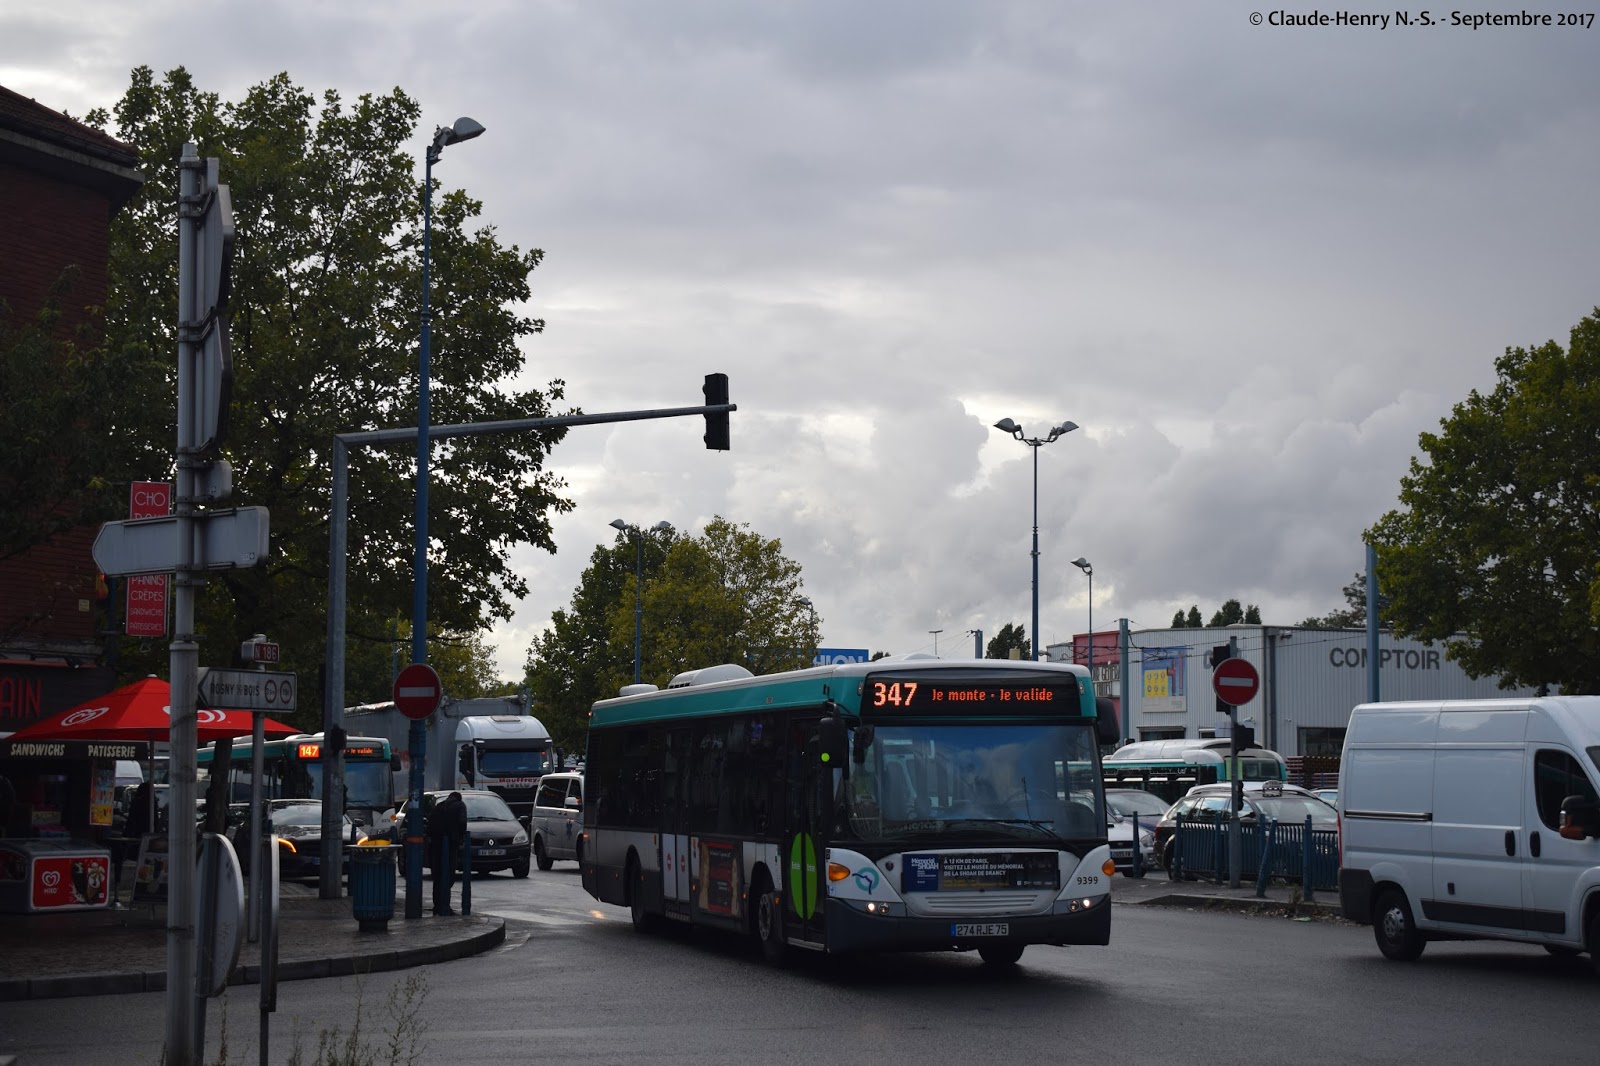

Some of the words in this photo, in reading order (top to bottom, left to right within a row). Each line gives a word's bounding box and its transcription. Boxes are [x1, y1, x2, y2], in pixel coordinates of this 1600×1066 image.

[134, 491, 166, 507] CHO
[129, 607, 163, 617] SANDWICHS
[255, 644, 260, 659] N
[263, 646, 277, 660] 186
[210, 683, 235, 696] ROSNY
[243, 685, 260, 696] BOIS
[873, 682, 918, 706] 347
[932, 688, 943, 701] Je
[948, 689, 986, 701] monte
[999, 688, 1011, 701] Je
[1015, 687, 1053, 701] valide
[10, 743, 66, 757] SANDWICHS
[87, 744, 136, 758] PATISSERIE
[300, 745, 320, 758] 147
[917, 862, 939, 870] SHOAH
[1077, 877, 1100, 887] 9399
[957, 925, 975, 936] 274
[976, 925, 993, 935] RJE
[995, 924, 1007, 935] 75
